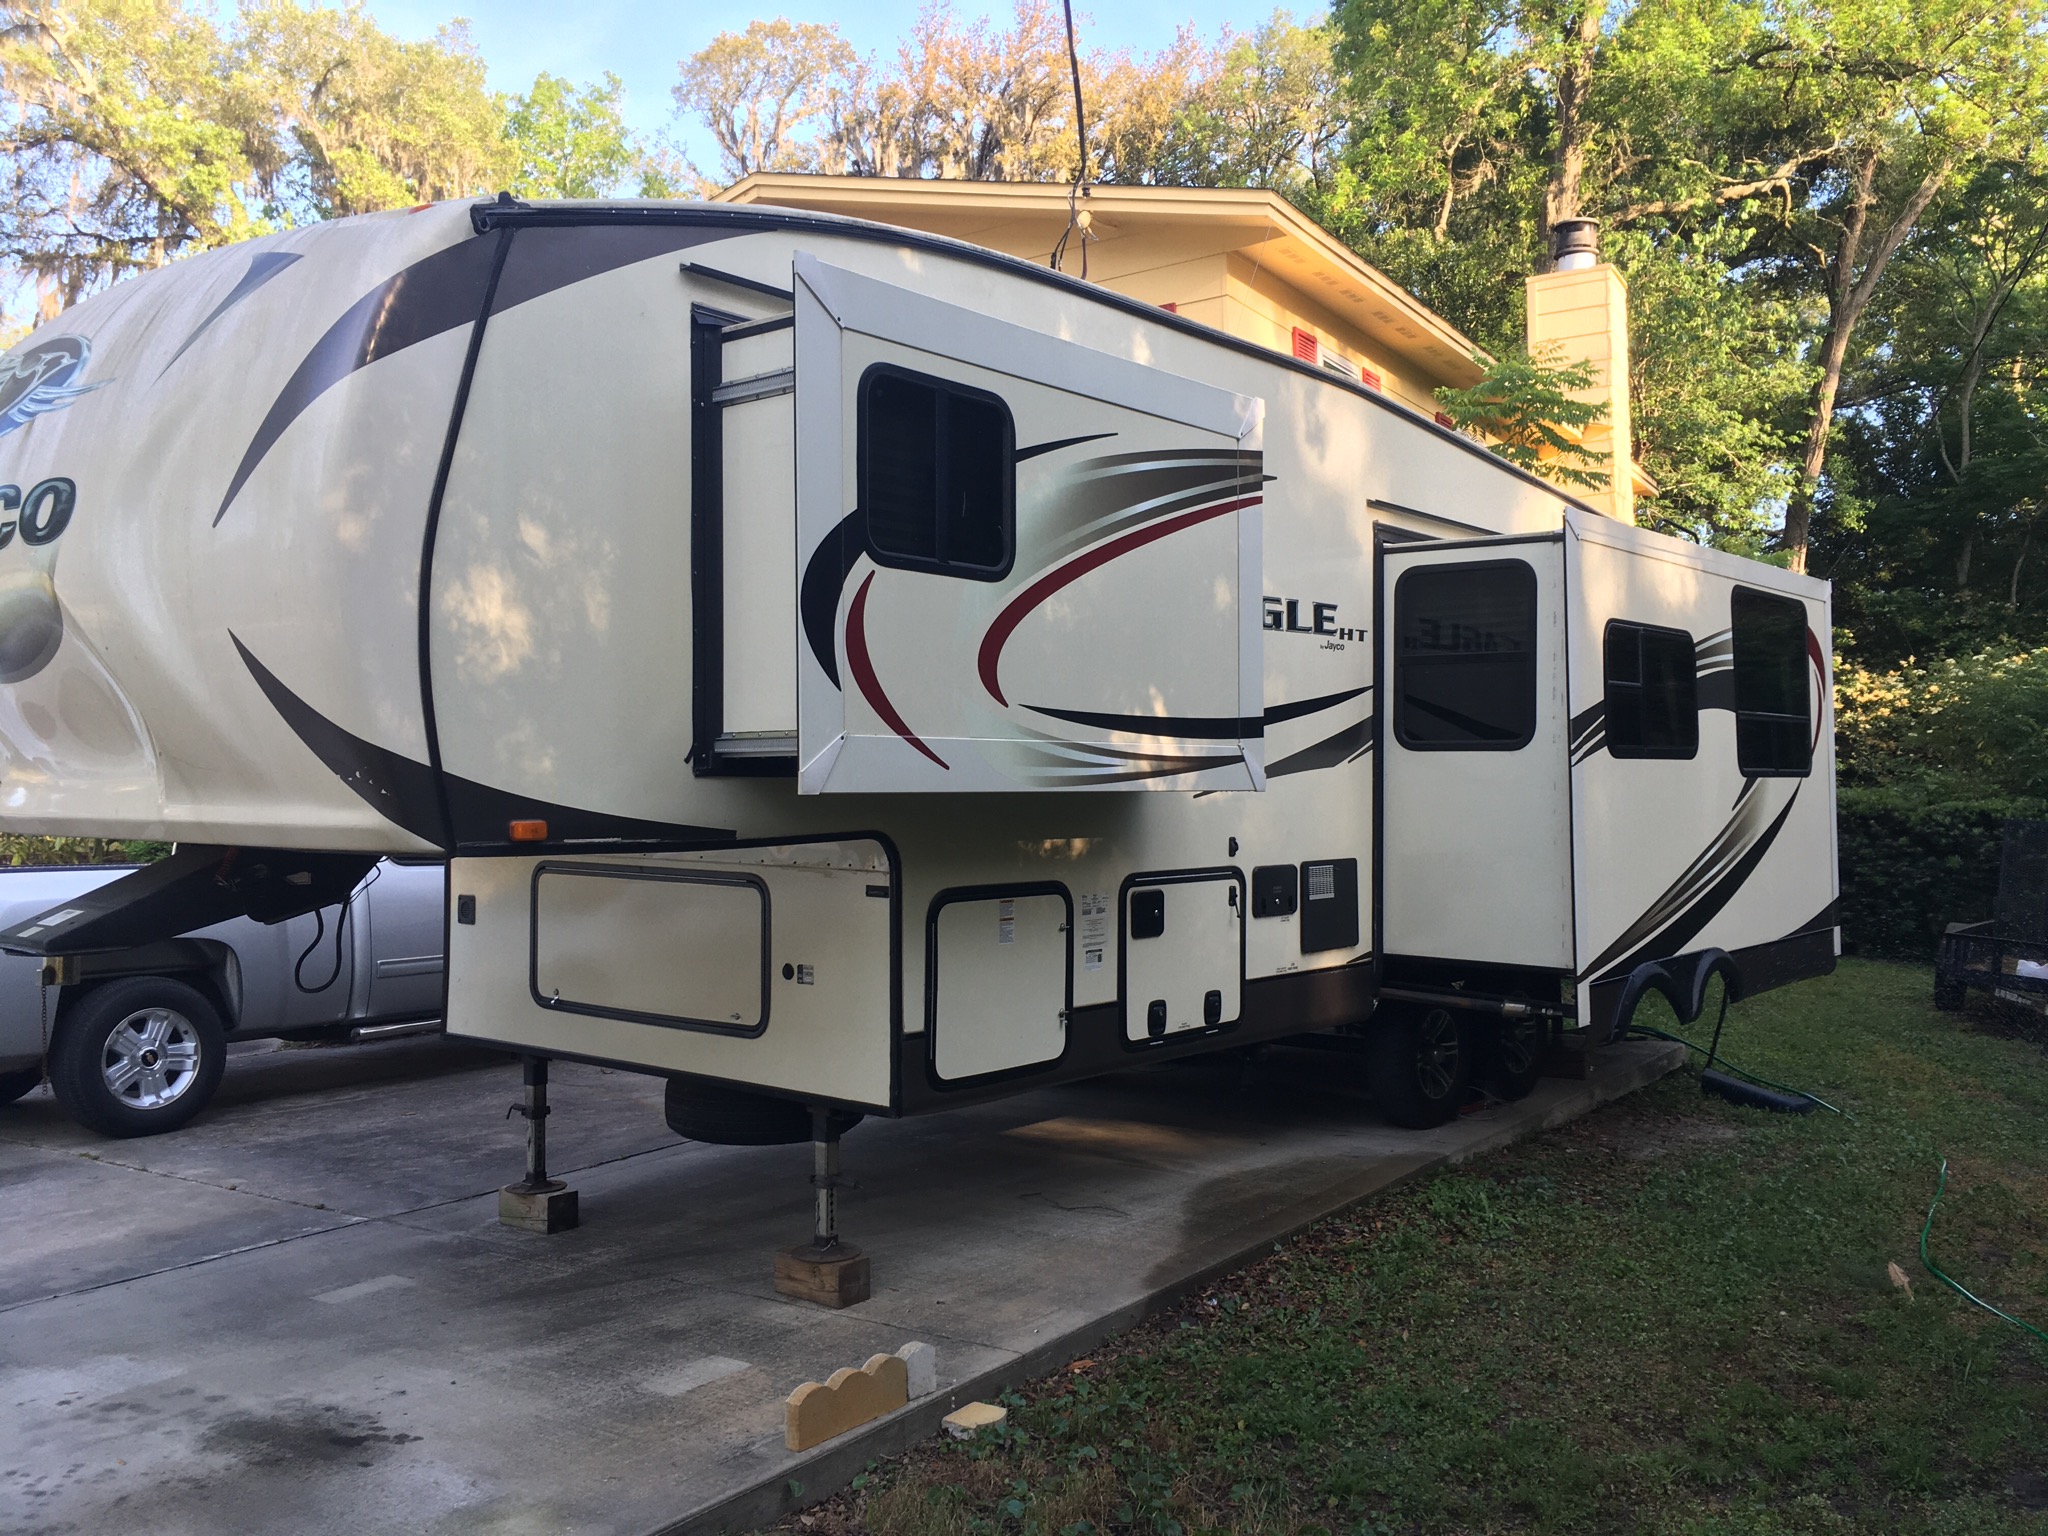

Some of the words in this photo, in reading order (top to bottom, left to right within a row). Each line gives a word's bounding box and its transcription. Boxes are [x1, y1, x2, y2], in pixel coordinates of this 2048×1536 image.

[1263, 596, 1338, 636] GLE
[1339, 628, 1368, 642] HT
[1324, 640, 1345, 652] Jayco
